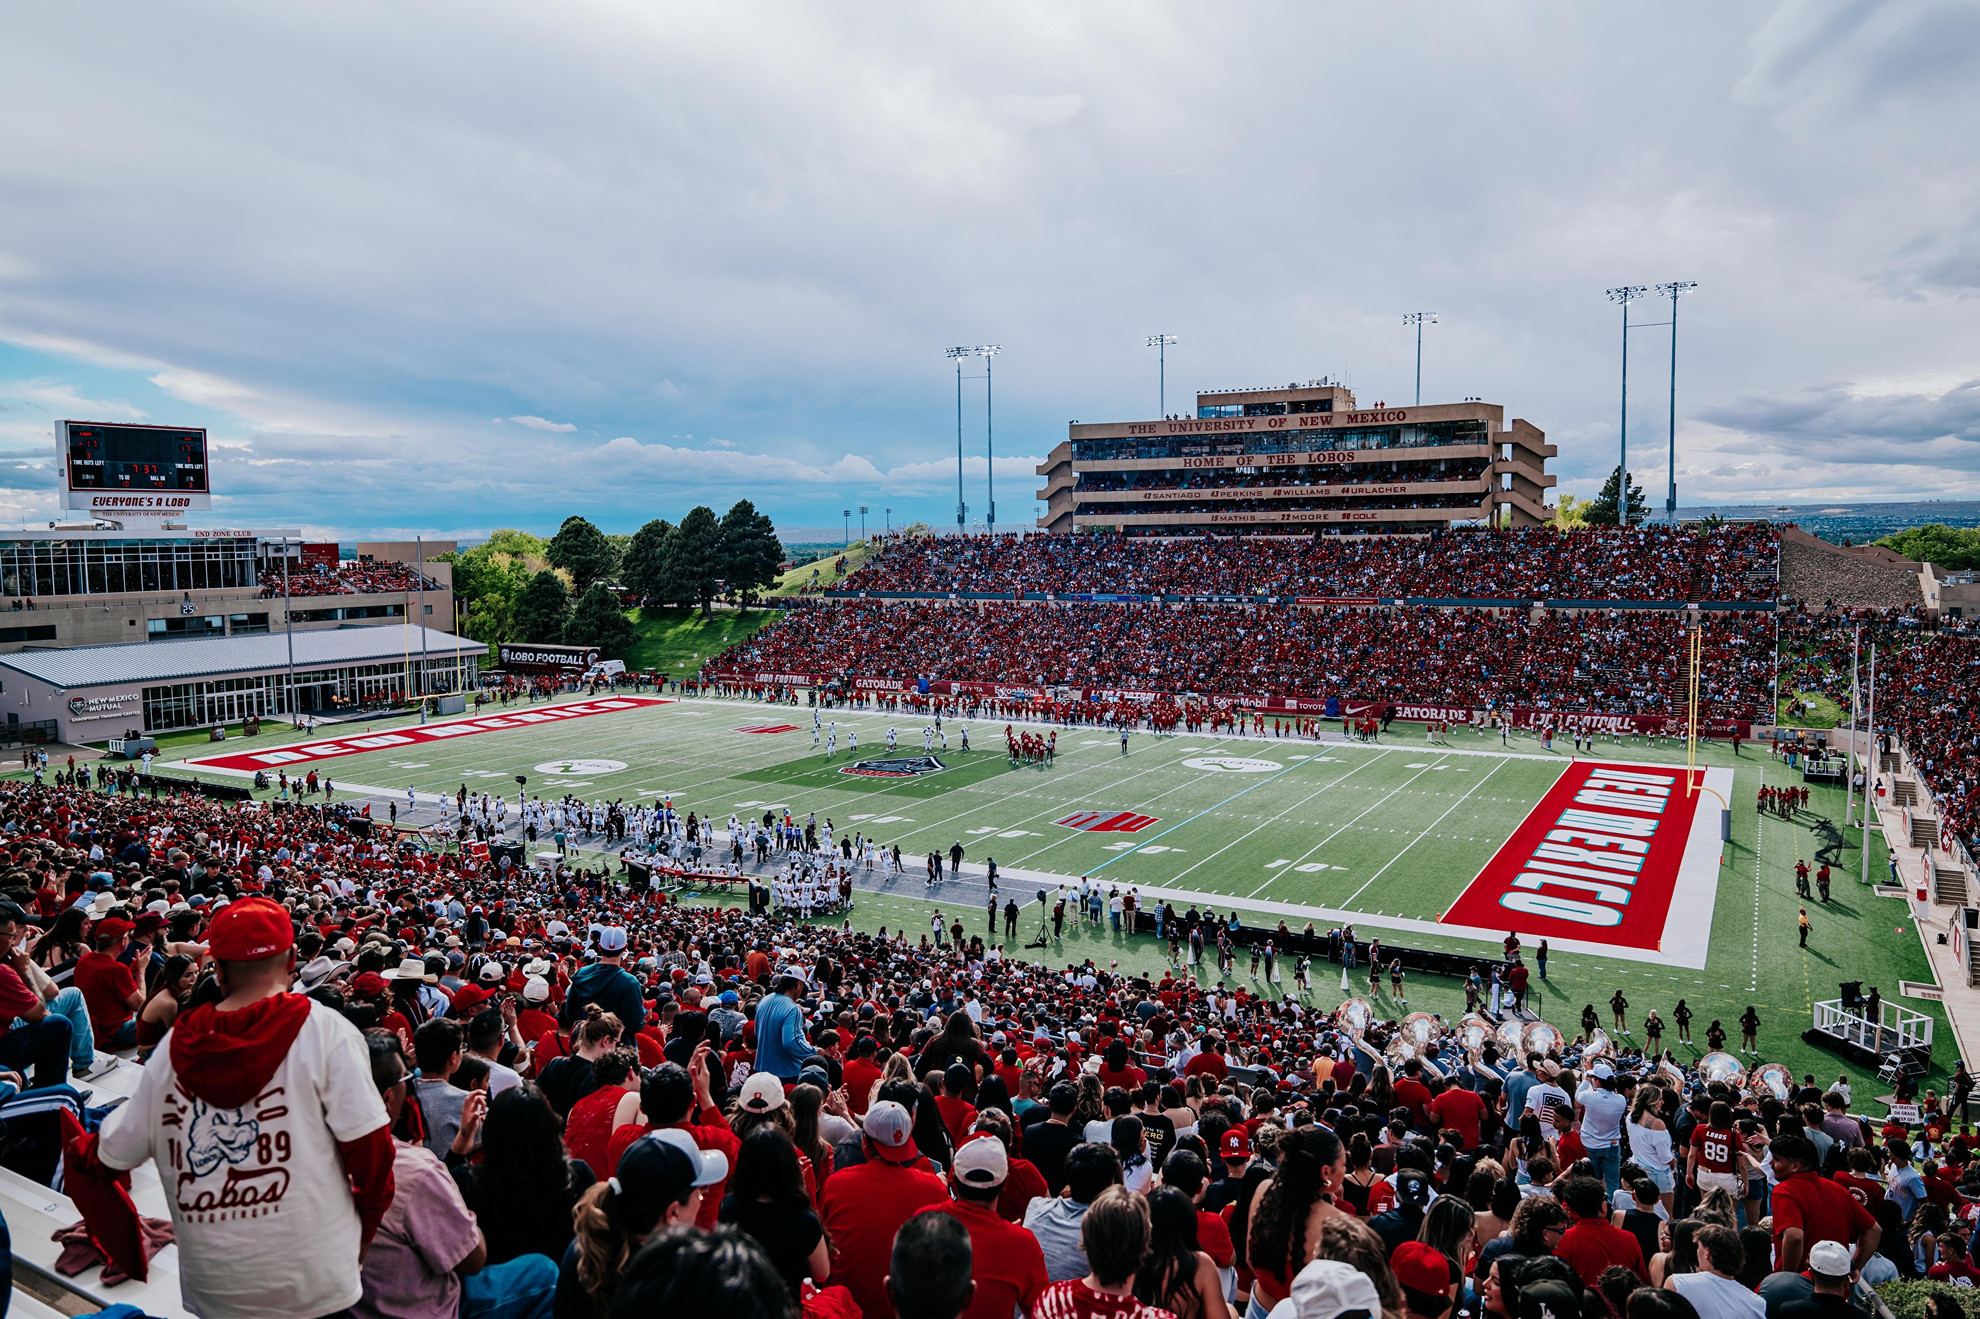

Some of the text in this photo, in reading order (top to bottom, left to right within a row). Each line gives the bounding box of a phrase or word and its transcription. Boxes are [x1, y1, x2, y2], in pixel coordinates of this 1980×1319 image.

[1129, 411, 1406, 434] THE UNIVERSITY OF NEW MEXICO
[1183, 452, 1355, 467] HOME OF THE LOBOS
[132, 464, 157, 474] 7:37
[92, 496, 190, 507] EVERYONE'S A LOBO
[510, 652, 584, 665] LOBO FOOTBALL
[755, 673, 773, 682] LOBO
[775, 674, 810, 685] FOOTBALL
[856, 678, 904, 689] GATORADE
[108, 694, 139, 702] MEXICO
[89, 703, 122, 712] MUTUAL
[1573, 768, 1676, 814] NEW
[1499, 808, 1660, 926] MEXICO
[1144, 1131, 1164, 1140] ERO
[1706, 1131, 1727, 1140] LOBOS
[257, 1130, 291, 1165] 89
[1705, 1141, 1728, 1163] 89
[176, 1166, 290, 1212] Lobos
